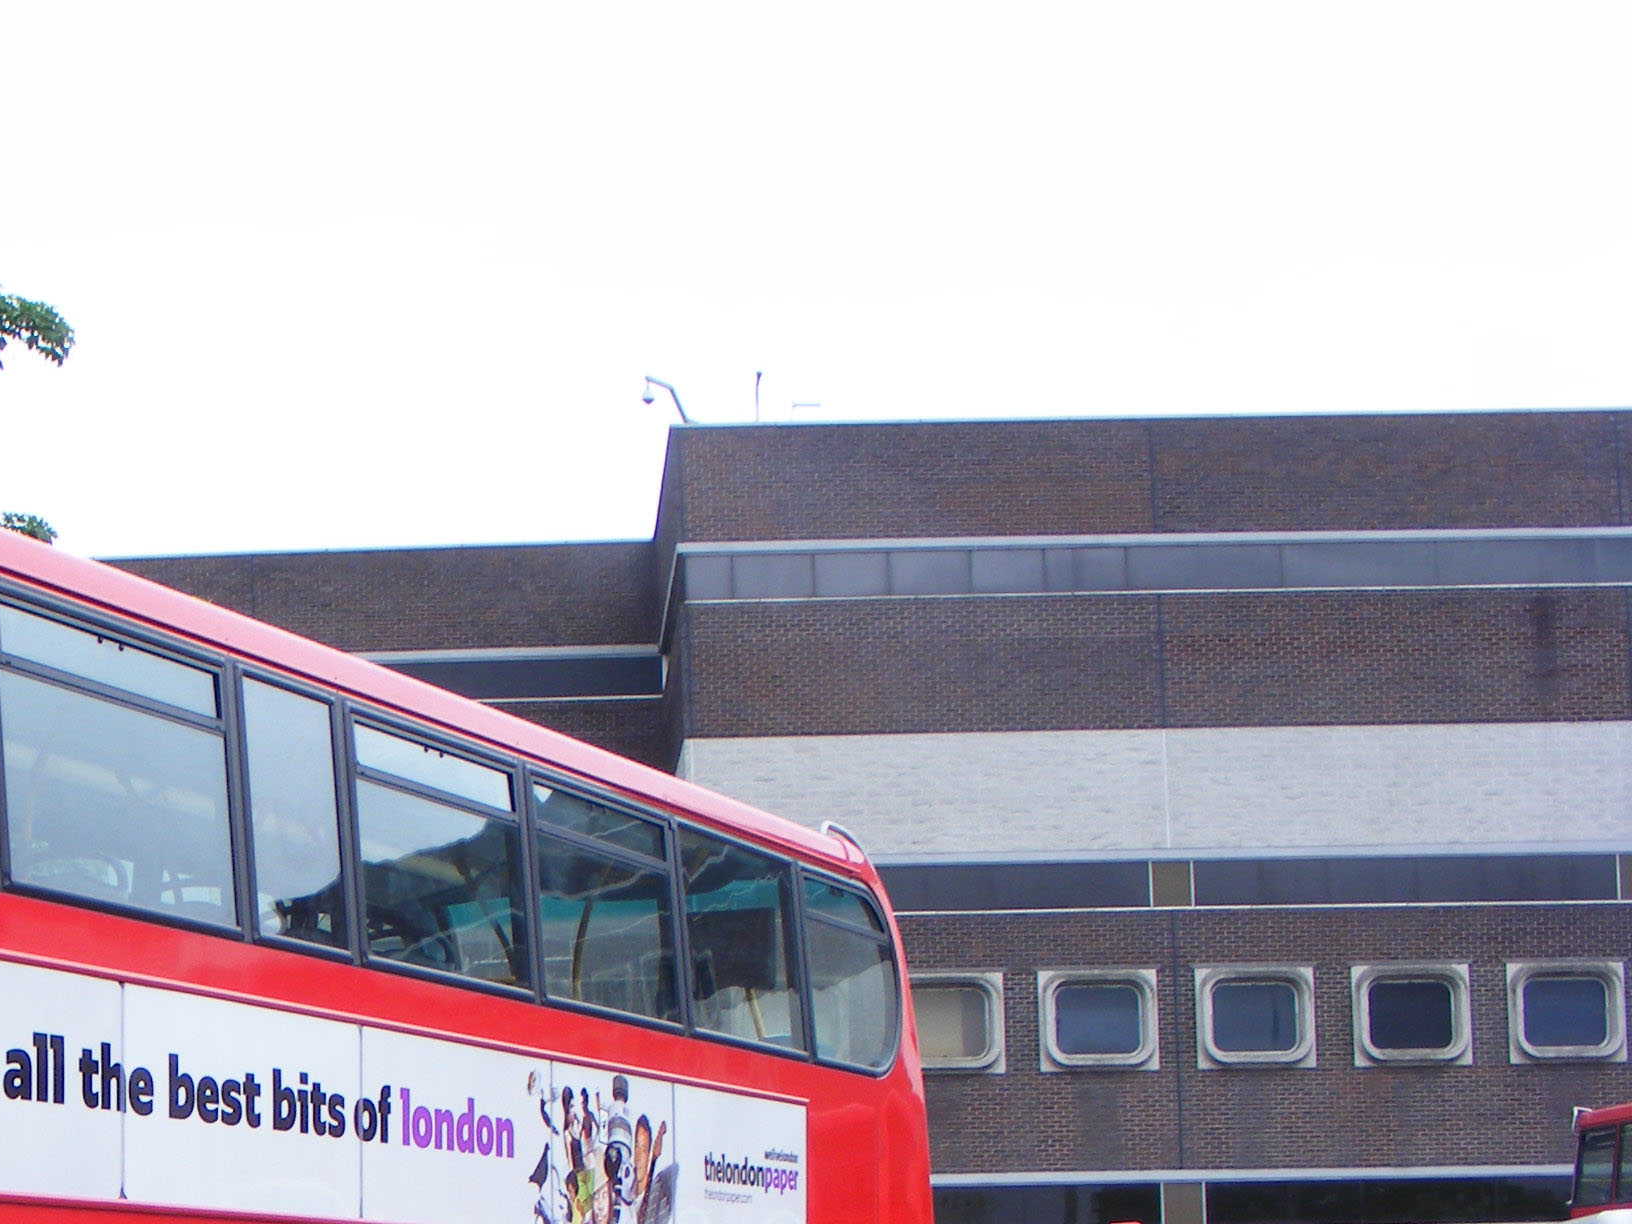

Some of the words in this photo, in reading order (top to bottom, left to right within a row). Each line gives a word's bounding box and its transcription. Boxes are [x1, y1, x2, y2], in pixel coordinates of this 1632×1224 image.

[3, 1032, 64, 1103] all
[79, 1042, 154, 1116] the
[169, 1054, 262, 1128] best
[273, 1067, 346, 1138] bits
[354, 1085, 391, 1144] of
[400, 1088, 515, 1159] london
[704, 1151, 798, 1195] thelondonpaper
